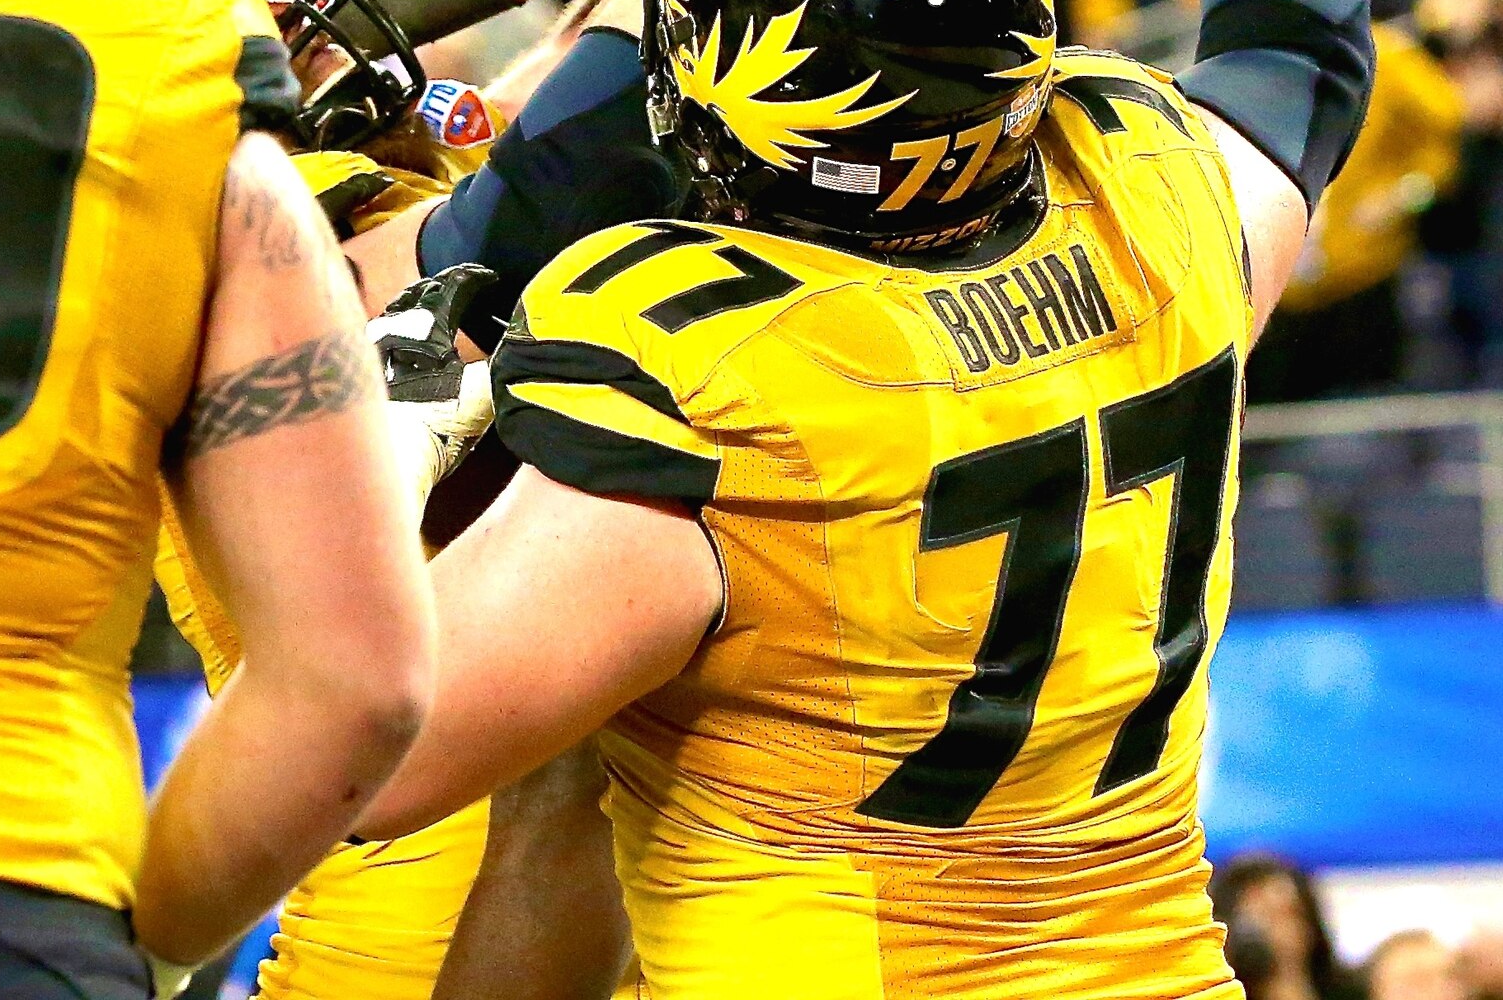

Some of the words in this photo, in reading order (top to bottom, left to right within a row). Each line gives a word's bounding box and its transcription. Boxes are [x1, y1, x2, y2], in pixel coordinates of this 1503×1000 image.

[876, 113, 1004, 211] 77
[562, 221, 806, 334] 77
[926, 244, 1120, 375] BOEHM
[854, 342, 1237, 828] 77
